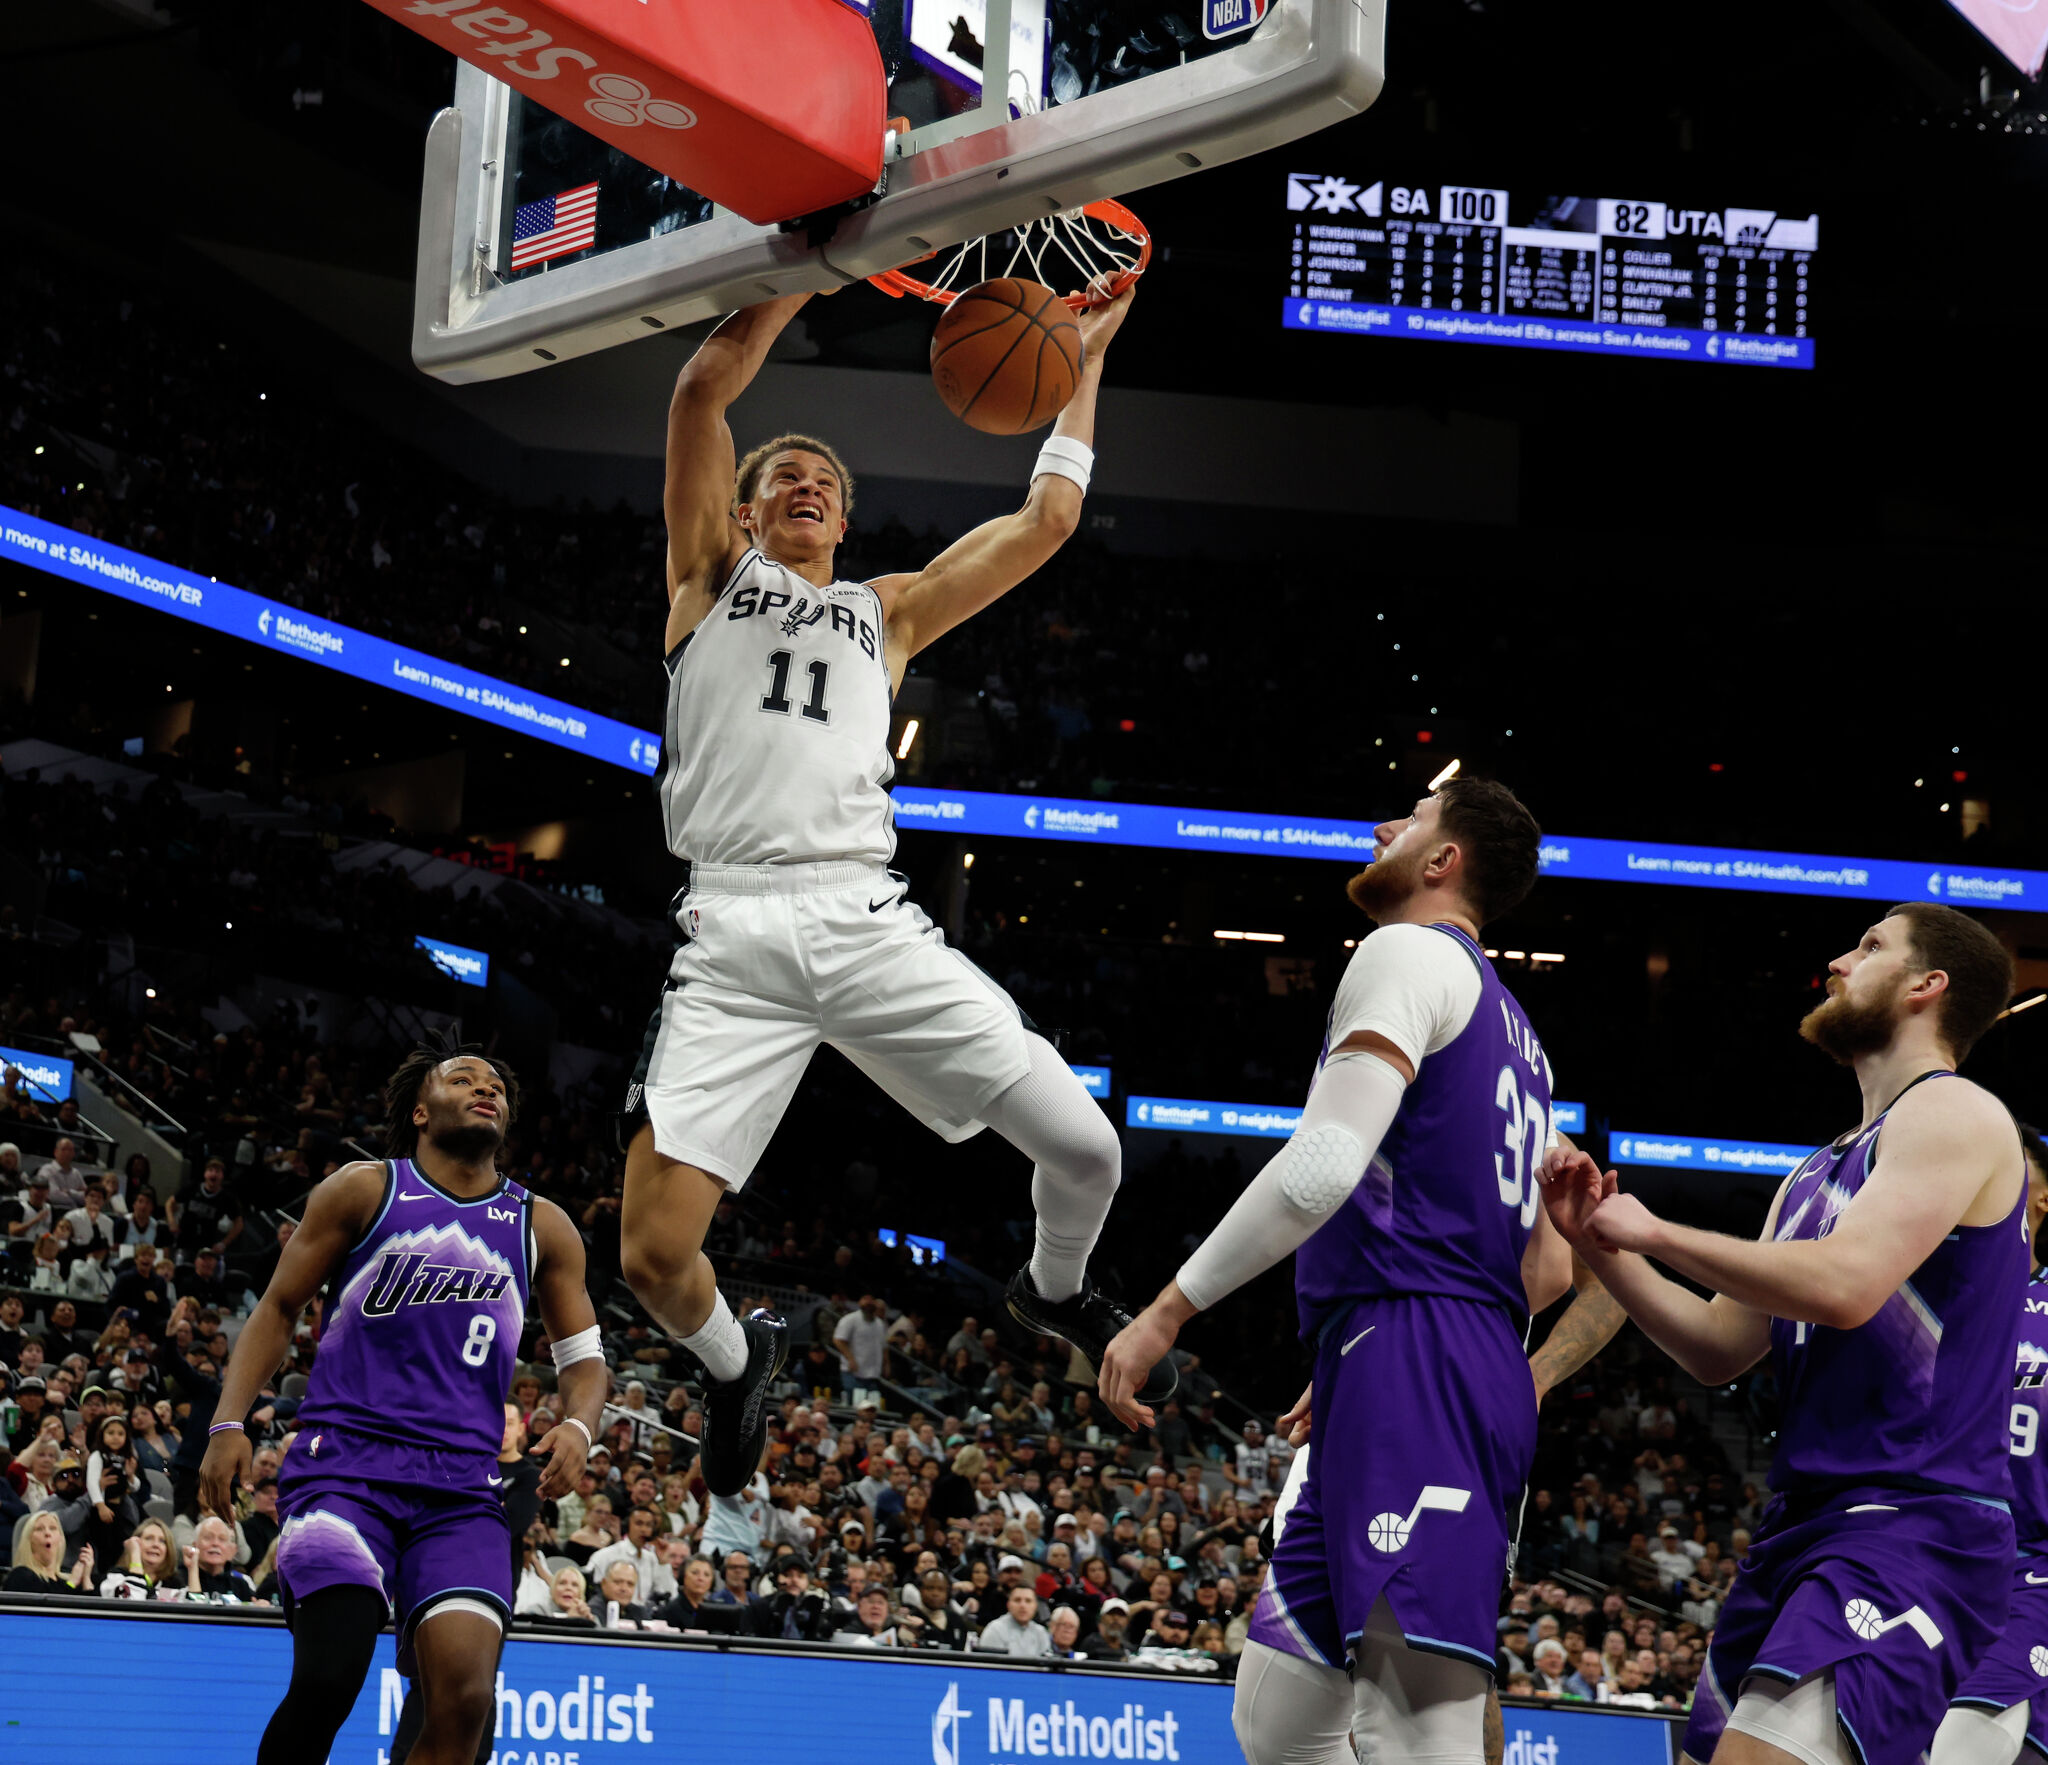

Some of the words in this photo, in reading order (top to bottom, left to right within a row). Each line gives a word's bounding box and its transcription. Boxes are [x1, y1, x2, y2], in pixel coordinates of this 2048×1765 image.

[1213, 0, 1244, 28] NBA
[1390, 187, 1431, 215] SA
[1449, 191, 1496, 222] 100
[1616, 204, 1649, 234] 82
[1666, 208, 1724, 238] UTA
[1308, 240, 1356, 256] HARPER
[1623, 250, 1672, 266] COLLIER
[1308, 256, 1367, 272] JOHNSON
[1307, 270, 1332, 285] FOX
[1622, 281, 1674, 297] CLAYTON
[1307, 286, 1354, 302] BRYANT
[1622, 295, 1663, 312] BAILEY
[1318, 305, 1391, 326] Methodist
[1407, 314, 1425, 330] 10
[1425, 316, 1524, 339] neighborhood
[1525, 323, 1554, 341] ERs
[1555, 329, 1601, 345] across
[1603, 330, 1631, 347] San
[1632, 332, 1691, 352] Antonio
[1724, 336, 1799, 359] Methodist
[5, 526, 47, 553] more
[49, 542, 67, 561] at
[69, 546, 203, 607] SAHealth.com/ER
[832, 590, 866, 599] LEDGER
[275, 616, 344, 654] Methodist
[728, 586, 876, 662] SPURS
[393, 658, 430, 686] Learn
[431, 676, 464, 698] more
[465, 687, 480, 703] at
[480, 687, 588, 739] SAHealth.com/ER
[760, 649, 831, 726] 11
[1044, 808, 1119, 830] Methodist
[1177, 820, 1220, 838] Learn
[1222, 827, 1262, 842] more
[1263, 828, 1280, 843] at
[1628, 853, 1671, 871] Learn
[1672, 859, 1713, 875] more
[1714, 861, 1732, 876] at
[1733, 861, 1868, 887] SAHealth.com/ER
[1947, 875, 2024, 896] Methodist
[1152, 1105, 1210, 1121] Methodist
[1222, 1111, 1238, 1126] 10
[1635, 1141, 1692, 1158] Methodist
[1703, 1147, 1721, 1162] 10
[487, 1206, 518, 1225] LVT
[361, 1252, 515, 1317] UTAH
[462, 1314, 497, 1367] 8
[2009, 1403, 2040, 1457] 9
[988, 1697, 1179, 1762] Methodist
